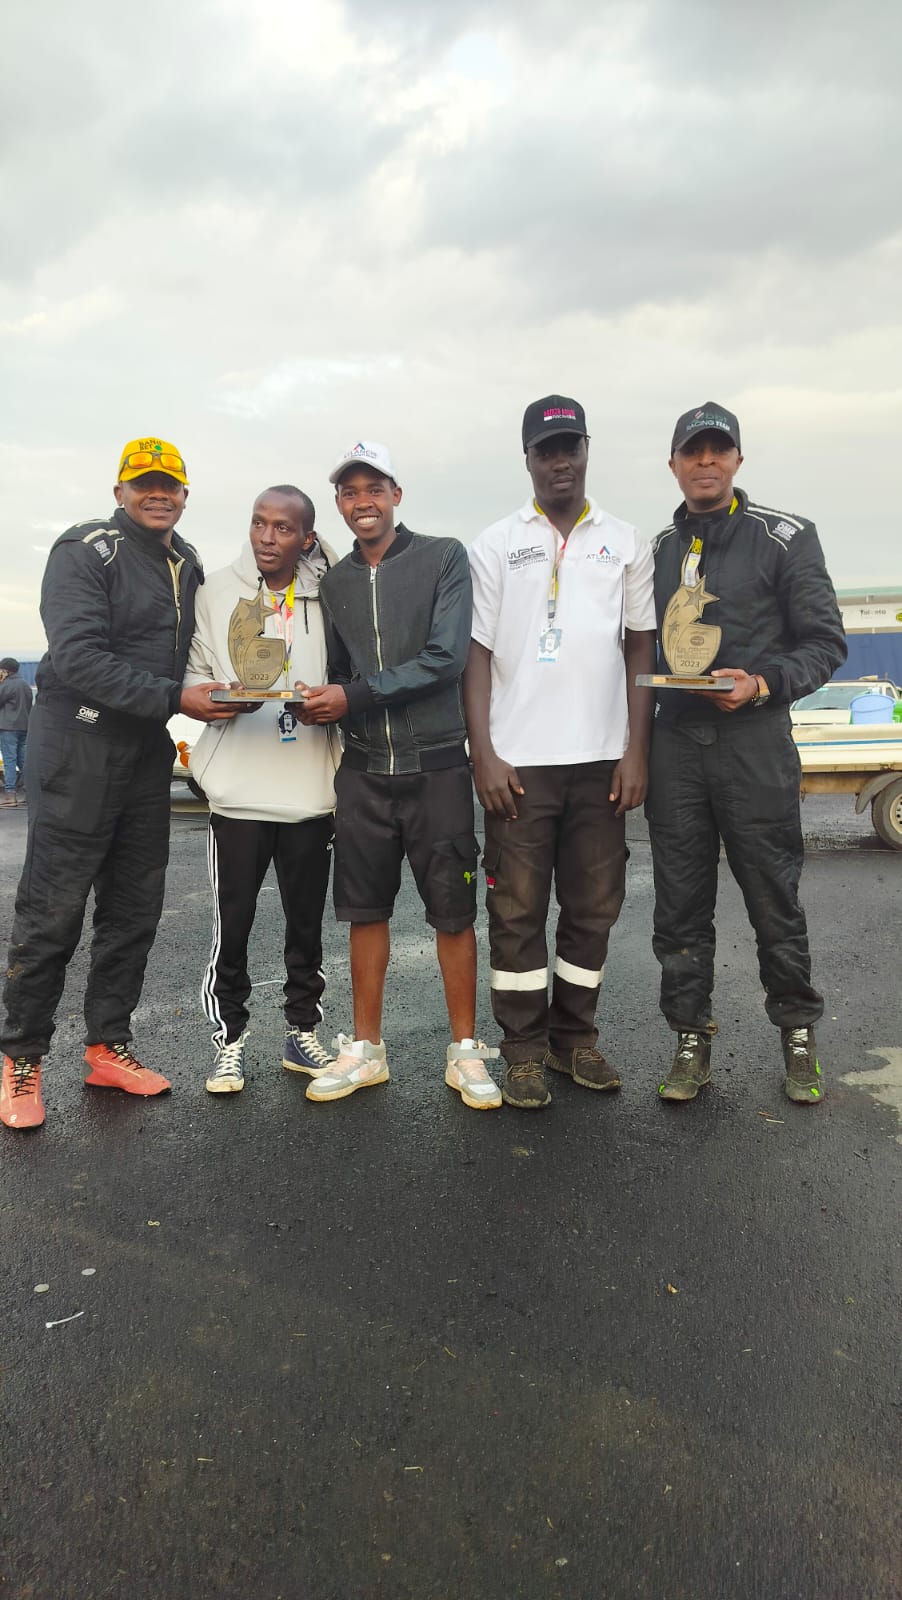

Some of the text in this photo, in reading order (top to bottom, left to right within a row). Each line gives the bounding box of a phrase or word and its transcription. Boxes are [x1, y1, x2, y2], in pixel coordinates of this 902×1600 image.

[680, 659, 700, 668] 2023
[250, 672, 269, 681] 2023
[79, 707, 99, 719] OMP
